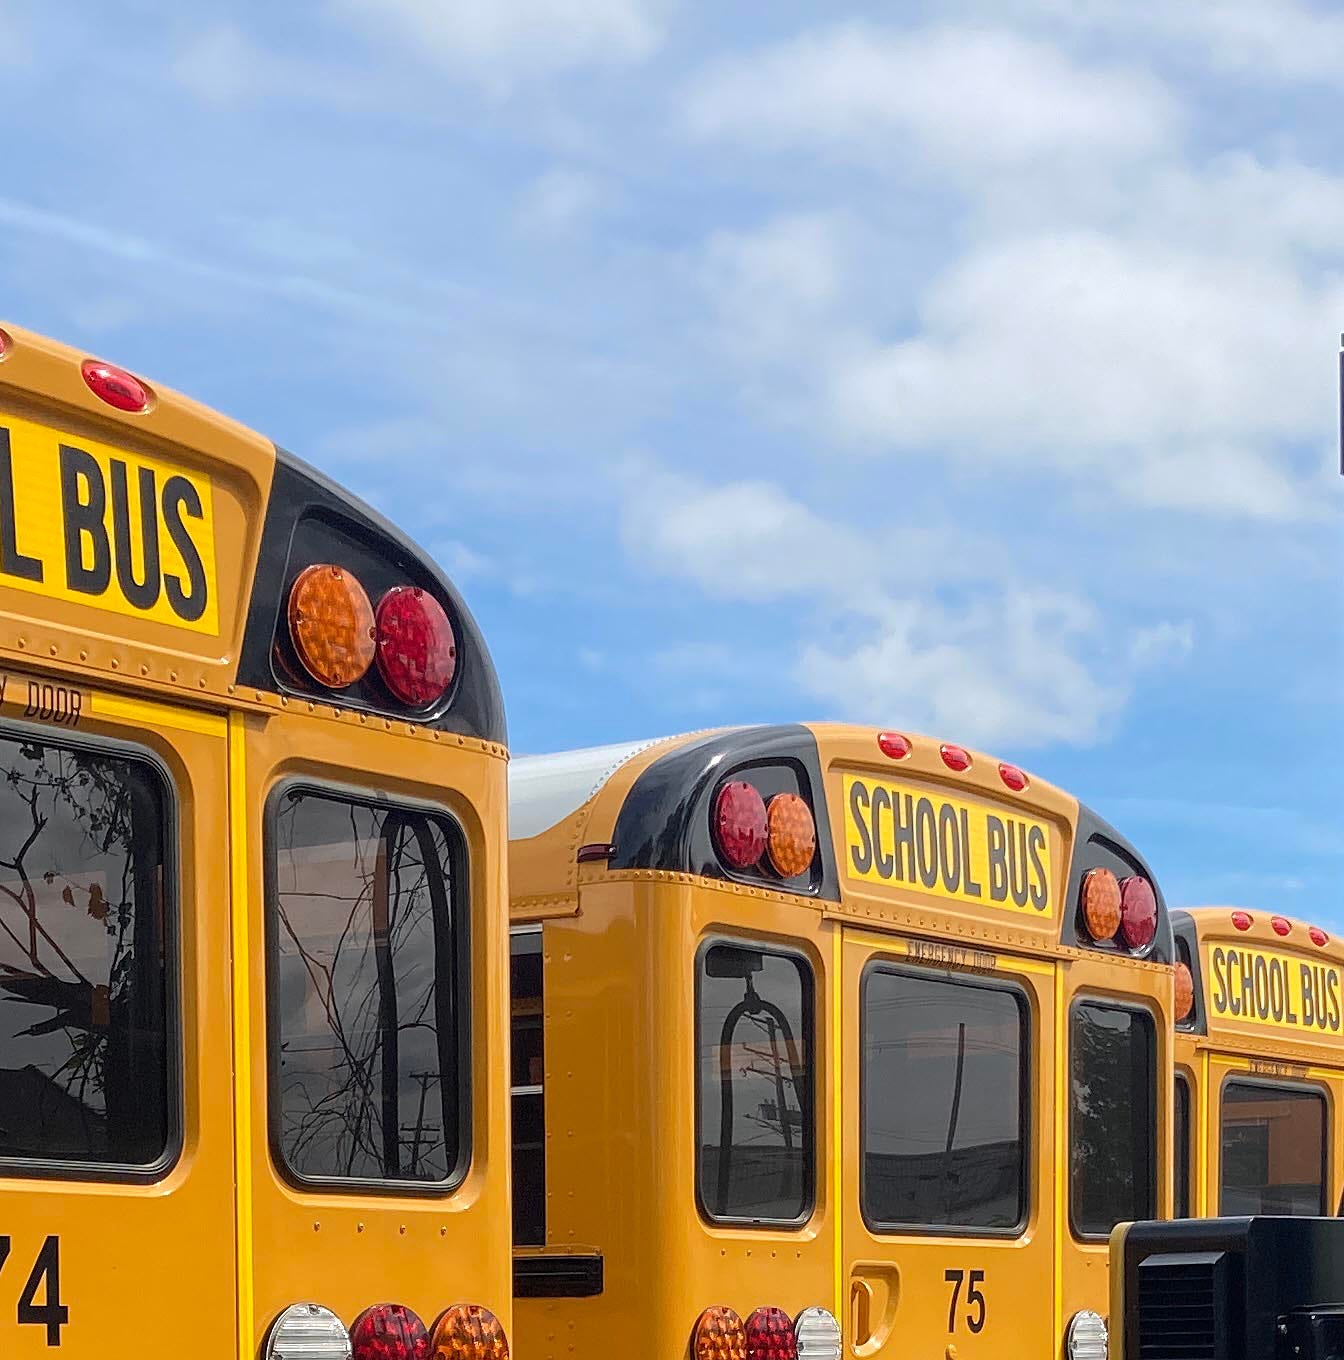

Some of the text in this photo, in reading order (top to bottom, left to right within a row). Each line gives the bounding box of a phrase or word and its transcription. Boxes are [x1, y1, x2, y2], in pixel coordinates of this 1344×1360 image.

[58, 442, 209, 623] BUS
[22, 679, 84, 728] DOOR
[849, 780, 1049, 912] SCHOOL BUS
[1212, 947, 1341, 1032] SCHOOL BUS
[944, 1269, 986, 1334] 75
